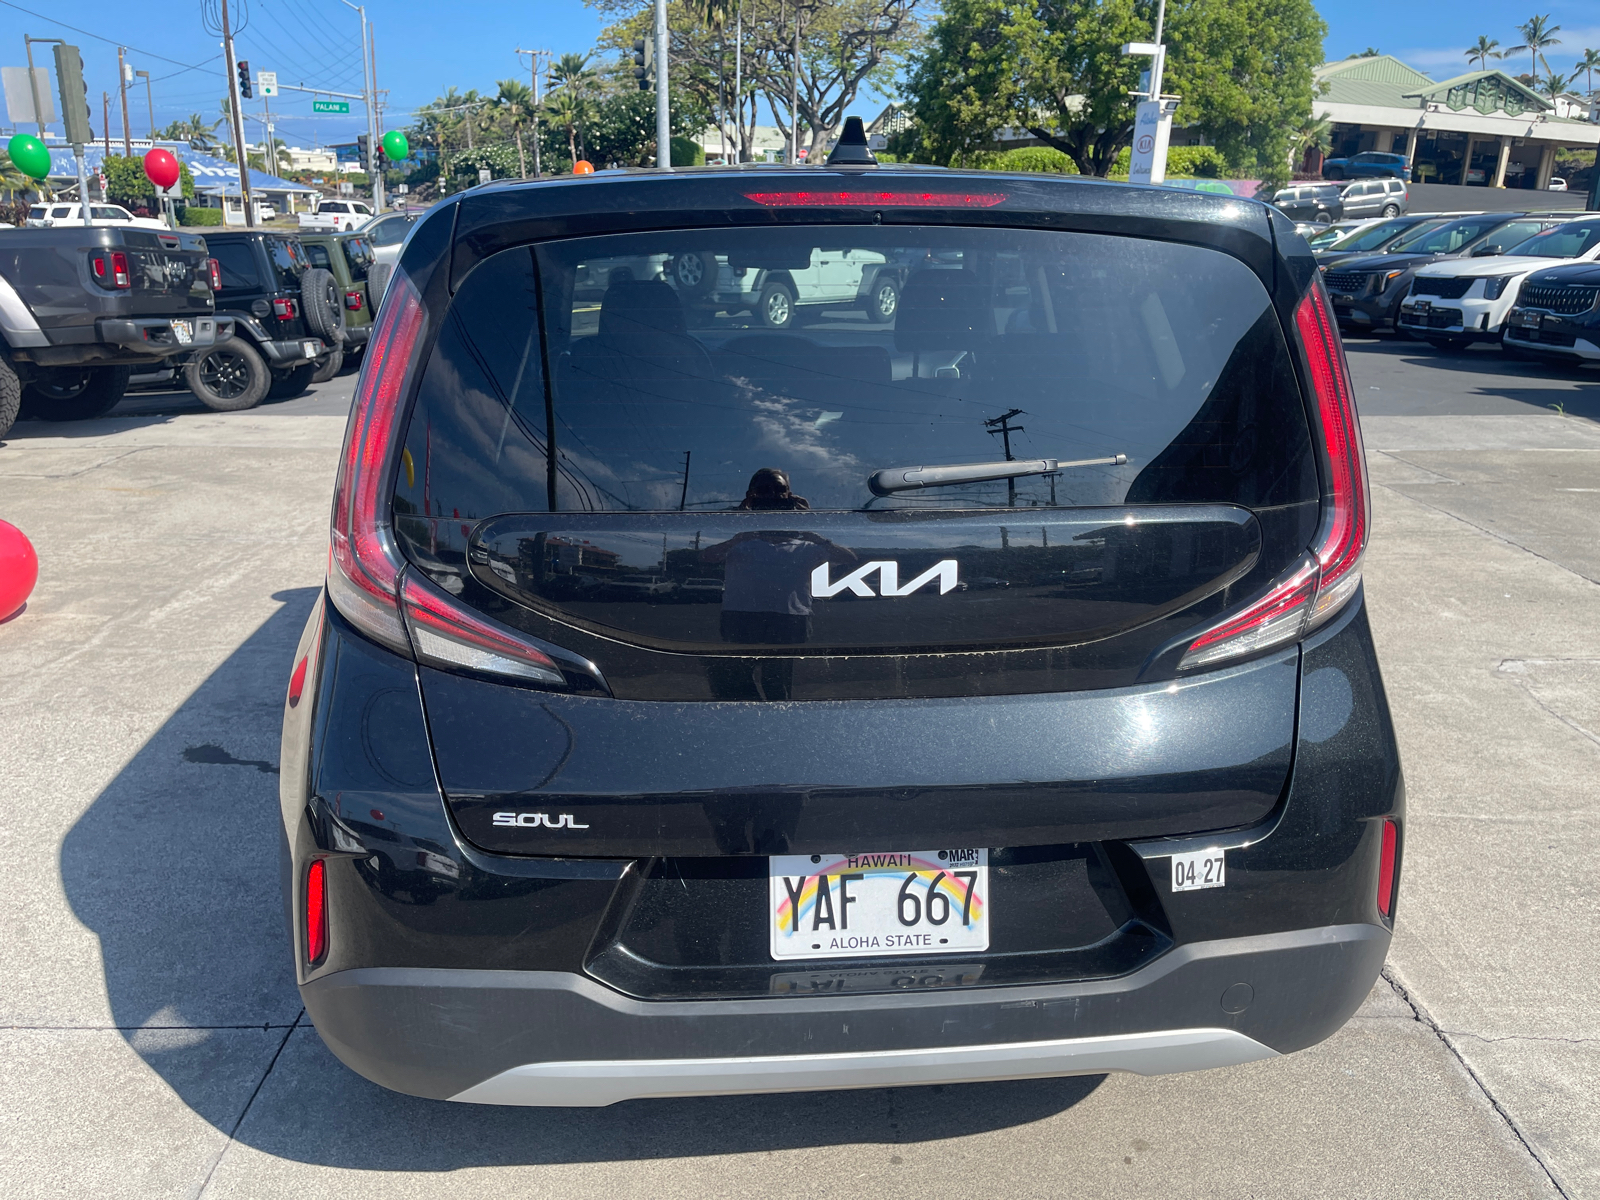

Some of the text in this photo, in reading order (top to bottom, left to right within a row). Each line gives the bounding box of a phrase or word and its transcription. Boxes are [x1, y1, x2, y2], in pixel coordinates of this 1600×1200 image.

[315, 103, 340, 112] PALANI
[1139, 139, 1152, 150] KIA
[811, 560, 958, 597] KIA
[492, 812, 590, 829] SOUL
[949, 848, 975, 862] MAR
[1175, 857, 1224, 887] 04 27
[783, 871, 978, 932] YAF 667
[829, 934, 932, 950] ALOHA STATE
